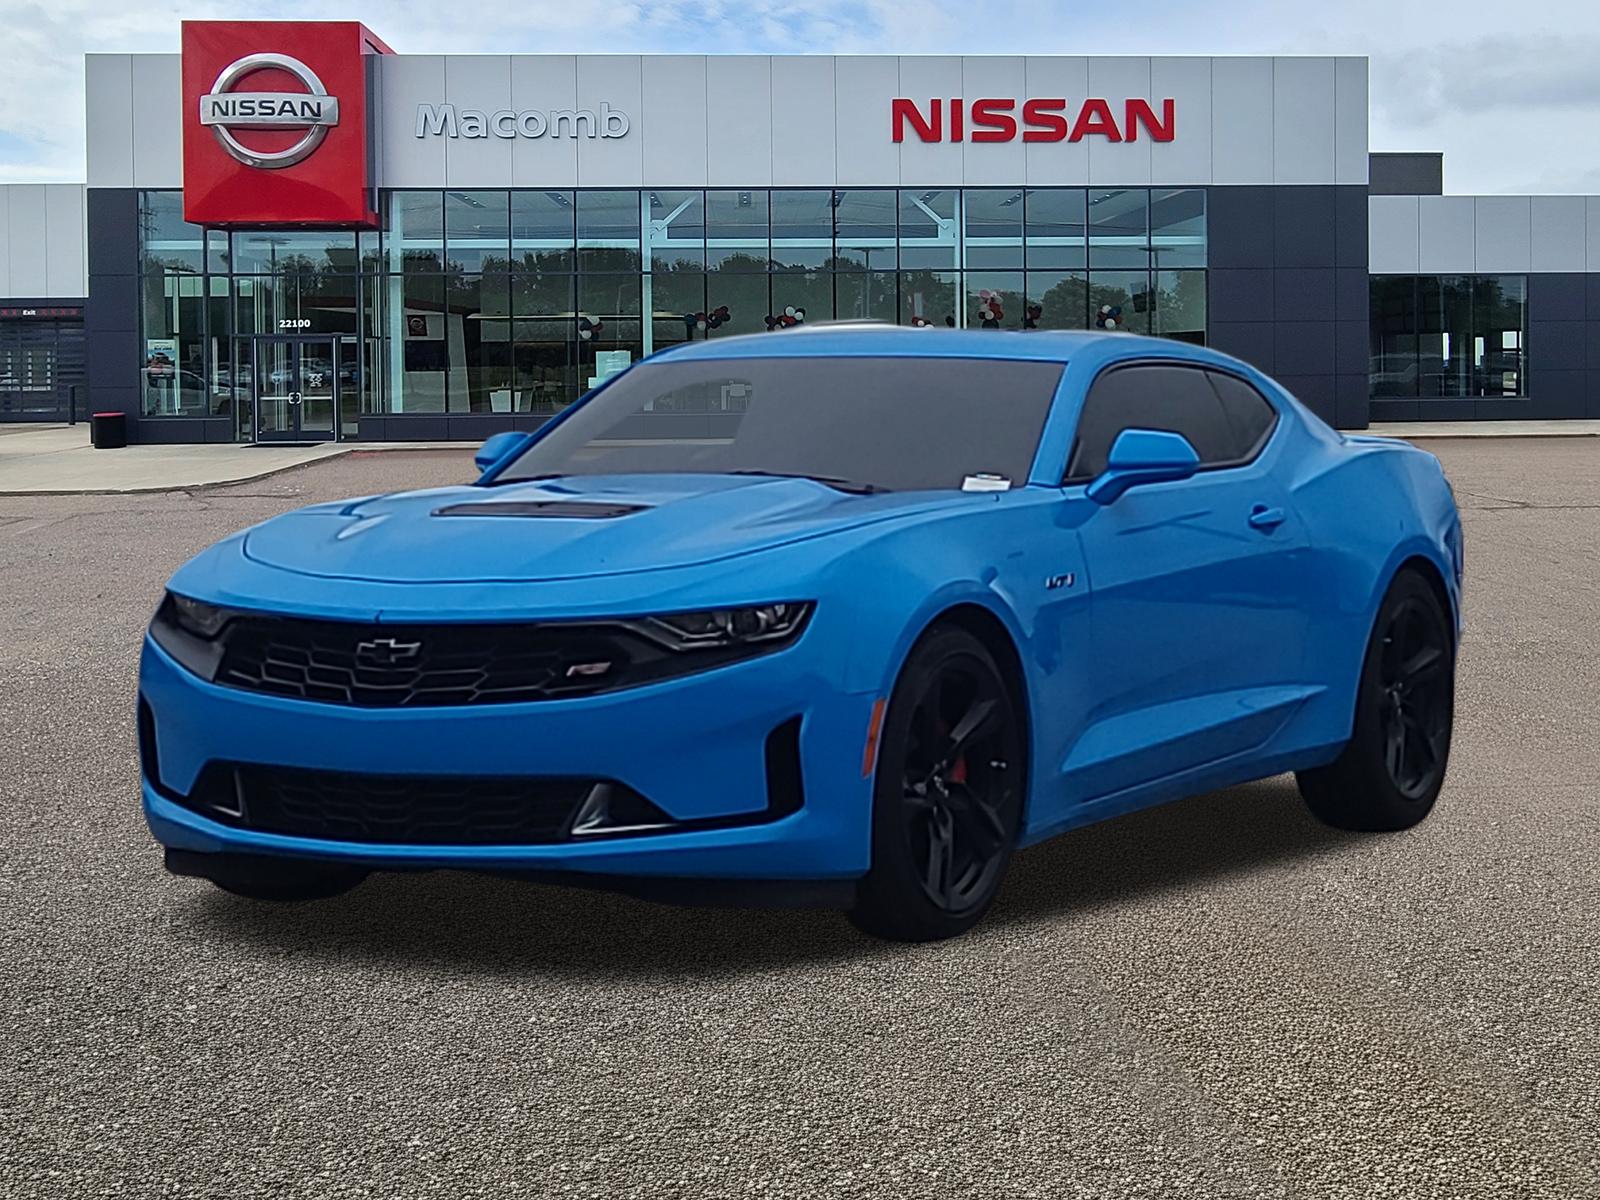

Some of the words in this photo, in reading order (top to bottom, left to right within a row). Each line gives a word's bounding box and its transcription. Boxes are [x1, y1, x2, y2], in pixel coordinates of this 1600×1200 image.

[211, 99, 322, 118] NISSAN
[415, 102, 630, 138] Macomb
[891, 98, 1176, 143] NISSAN
[279, 319, 311, 328] 22100
